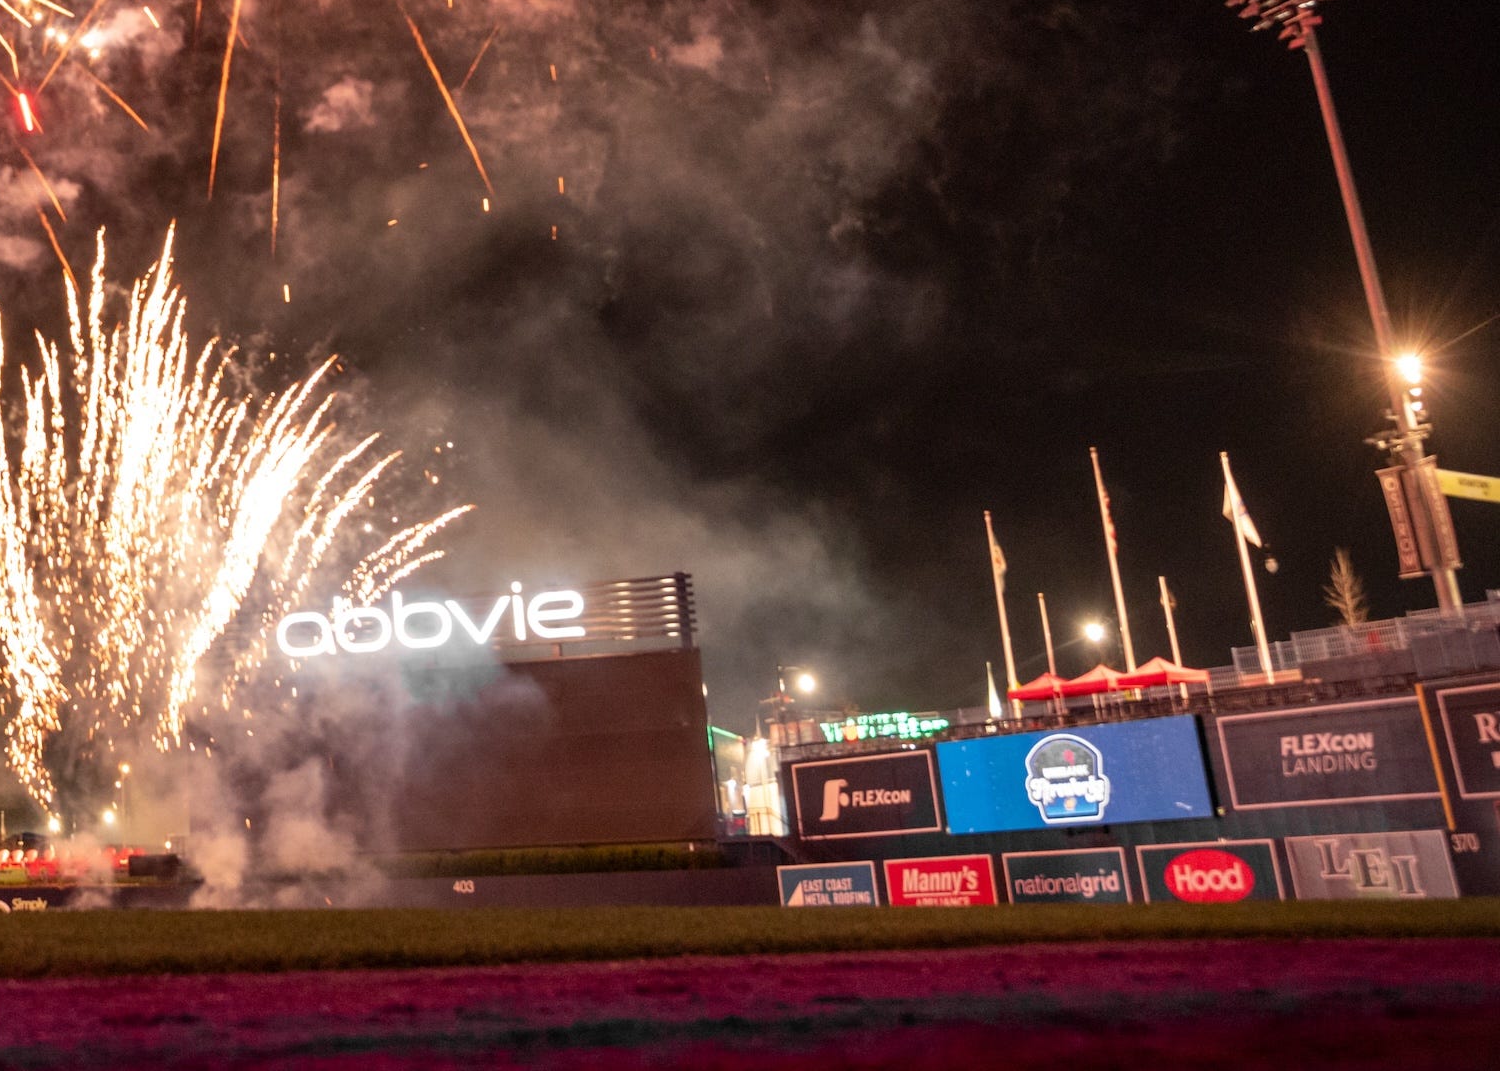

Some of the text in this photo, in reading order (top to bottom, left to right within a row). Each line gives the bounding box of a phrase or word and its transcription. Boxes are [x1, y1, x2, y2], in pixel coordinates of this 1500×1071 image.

[276, 581, 586, 657] abbvie
[1282, 751, 1377, 777] LANDING
[1451, 833, 1480, 852] 370
[1172, 862, 1245, 893] Hood
[1314, 838, 1427, 896] LEI
[453, 880, 475, 894] 403
[803, 878, 853, 892] EAST COAST
[902, 866, 979, 895] Manny's
[1014, 869, 1120, 898] nationalgrid
[12, 897, 48, 911] Simply
[803, 891, 871, 906] METAL ROOFING
